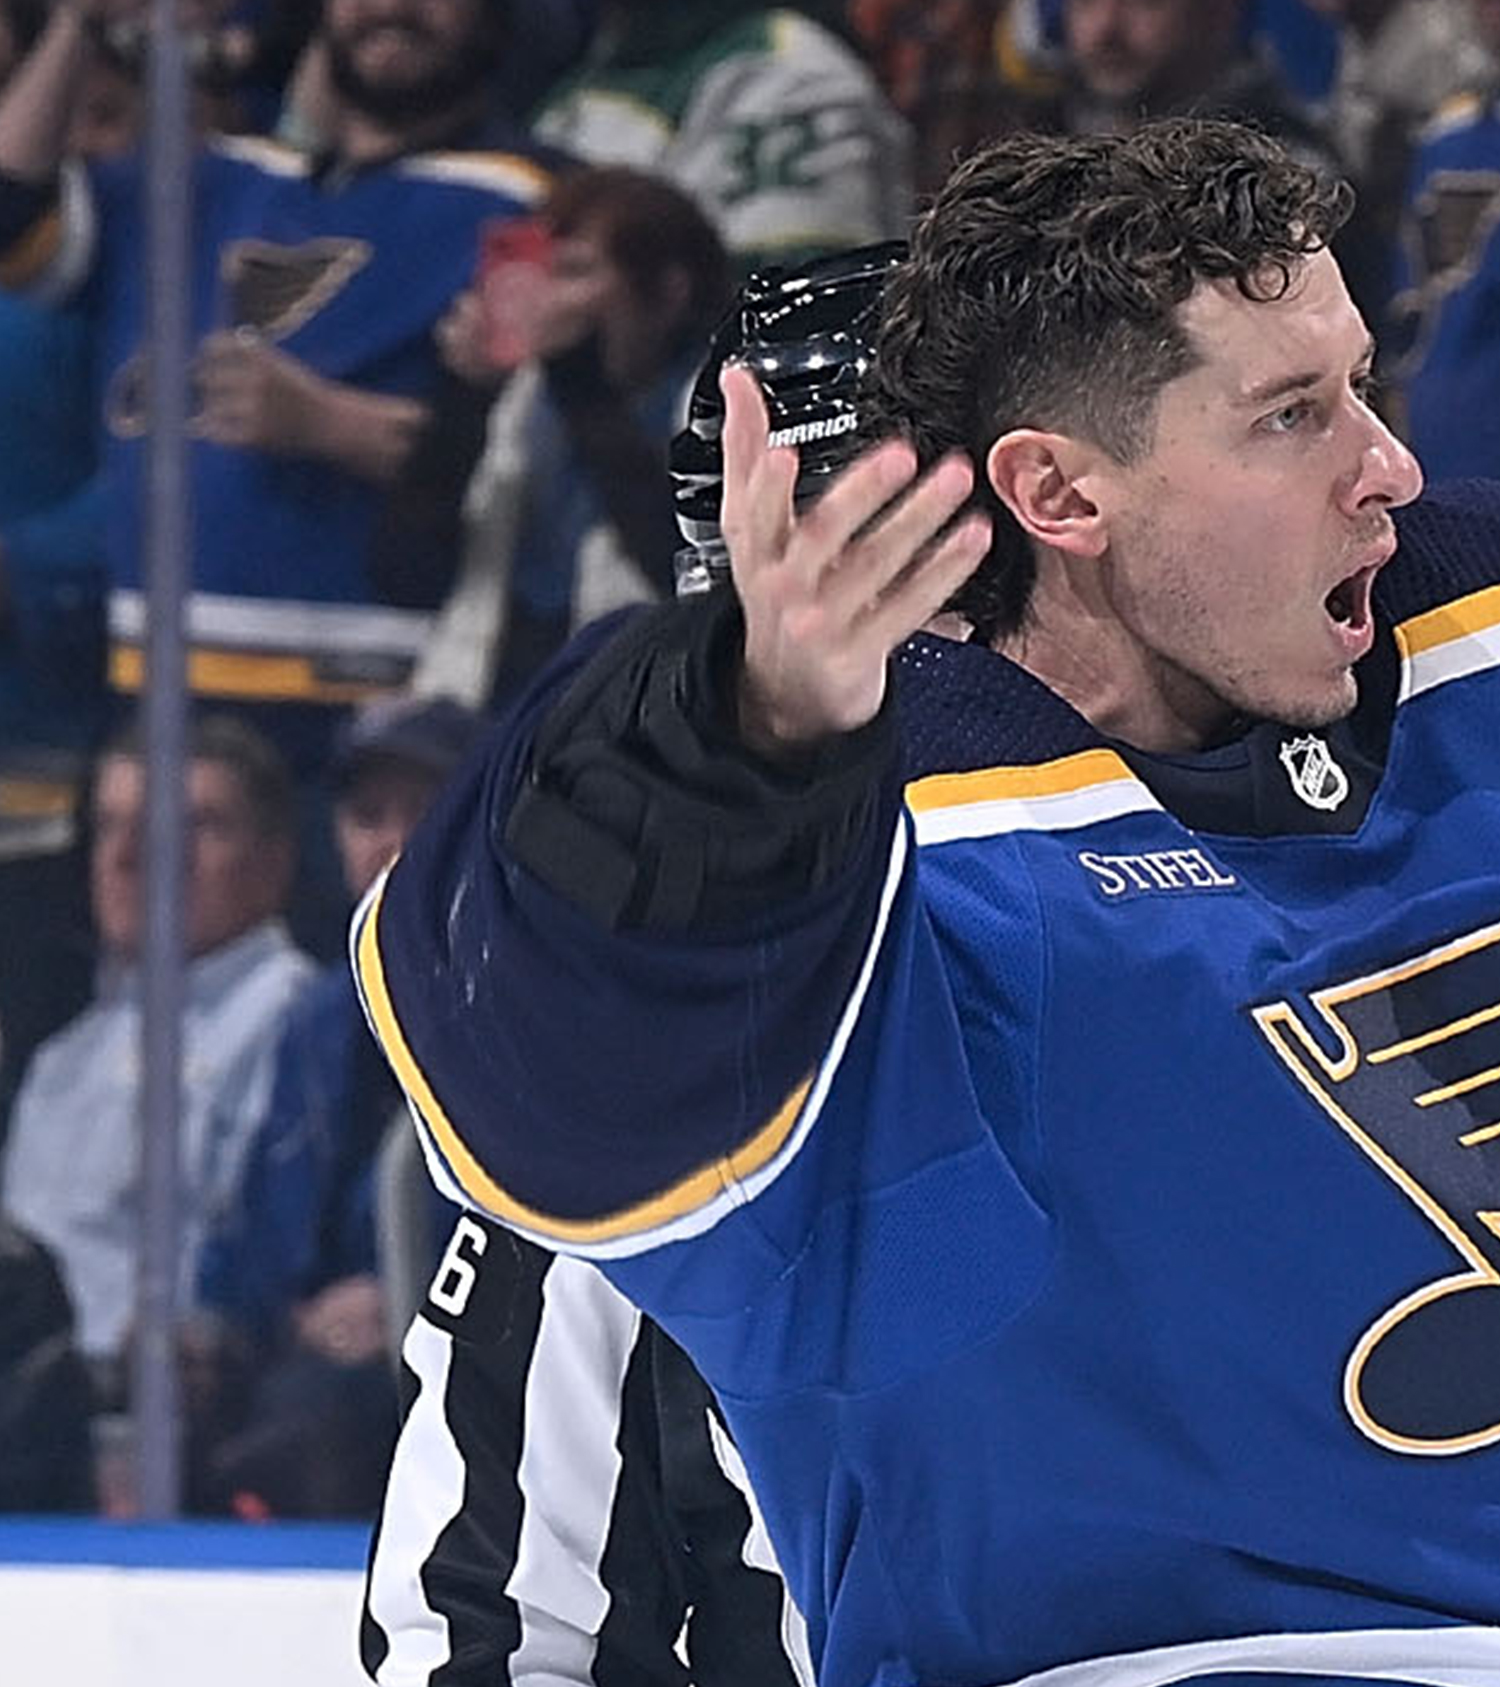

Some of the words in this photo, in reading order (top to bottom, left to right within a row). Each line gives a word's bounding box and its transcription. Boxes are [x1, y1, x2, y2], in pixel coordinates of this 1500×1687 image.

[717, 113, 823, 206] 32
[1078, 848, 1235, 896] STIFEL
[428, 1215, 488, 1317] 6
